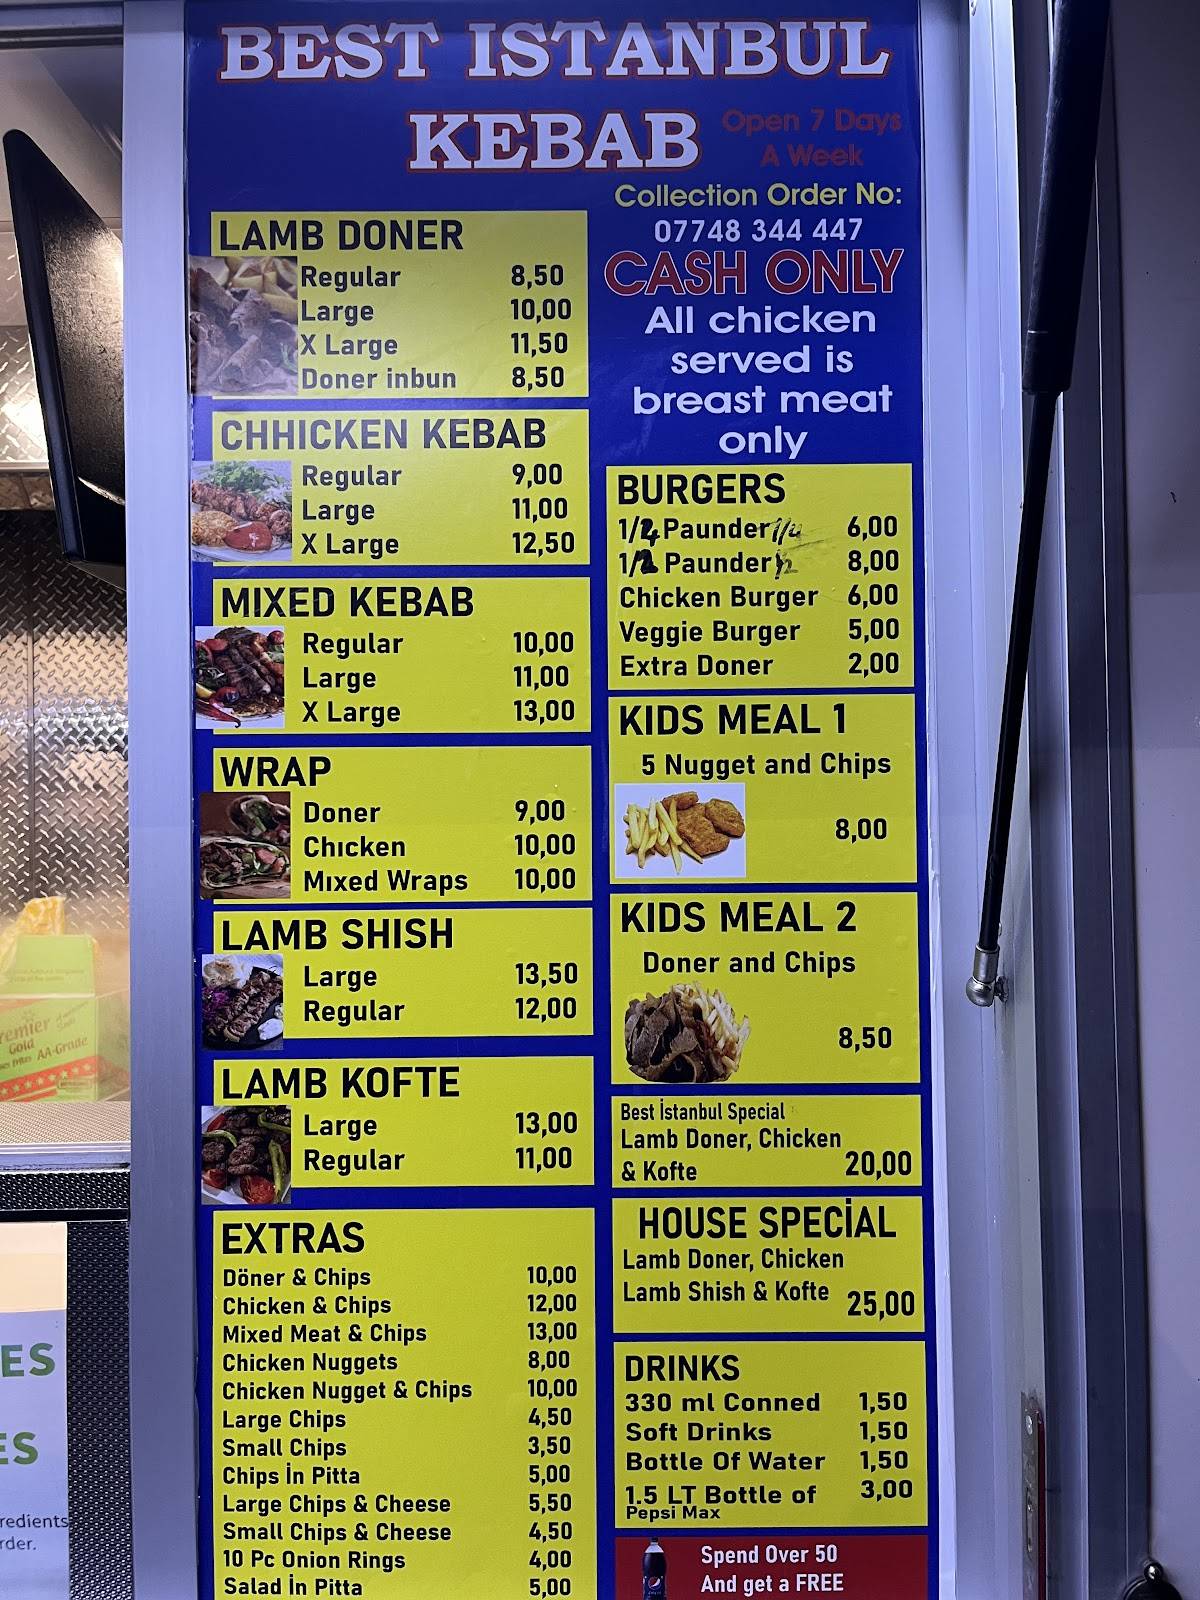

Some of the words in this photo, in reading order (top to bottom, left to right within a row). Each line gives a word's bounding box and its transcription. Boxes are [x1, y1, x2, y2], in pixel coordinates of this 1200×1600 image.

[219, 21, 441, 81] BEST
[467, 19, 891, 79] ISTANBUL
[721, 109, 800, 136] Open
[811, 107, 824, 130] 7
[835, 108, 901, 135] Days
[408, 111, 700, 171] KEBAB
[760, 144, 780, 166] A
[787, 144, 864, 167] Week
[615, 184, 757, 207] Collection
[768, 183, 847, 205] Order
[857, 182, 901, 204] No:
[220, 220, 323, 250] LAMB
[339, 220, 463, 250] DONER
[655, 219, 740, 242] 07748
[752, 219, 802, 242] 344
[813, 218, 862, 240] 447
[302, 266, 401, 292] Regular
[512, 265, 563, 289] 8,50
[604, 250, 746, 296] CASH
[765, 248, 904, 295] ONLY
[645, 306, 693, 333] All
[709, 305, 875, 333] chicken
[671, 345, 809, 374] served
[827, 345, 853, 372] is
[302, 368, 377, 389] Doner
[388, 368, 455, 388] inbun
[513, 367, 564, 392] 8,50
[634, 386, 766, 414] breast
[781, 385, 892, 412] meat
[222, 419, 407, 450] CHHICKEN
[424, 418, 545, 448] KEBAB
[719, 426, 808, 459] only
[619, 473, 785, 504] BURGERS
[664, 518, 771, 539] Paunder
[848, 516, 897, 541] 6,00
[666, 552, 772, 573] Paunder
[849, 550, 898, 575] 8,00
[223, 587, 334, 617] MIXED
[351, 587, 473, 616] KEBAB
[621, 587, 720, 608] Chicken
[732, 586, 818, 612] Burger
[848, 584, 897, 609] 6,00
[621, 656, 686, 676] Extra
[698, 655, 773, 675] Doner
[849, 653, 898, 678] 2,00
[304, 667, 376, 693] Large
[514, 666, 568, 690] 11,00
[621, 705, 703, 735] KIDS
[719, 704, 820, 734] MEAL
[834, 703, 844, 733] 1
[220, 757, 330, 786] WRAP
[642, 754, 654, 775] 5
[666, 754, 755, 780] Nugget
[765, 753, 810, 774] and
[821, 753, 890, 779] Chips
[836, 818, 886, 843] 8,00
[515, 834, 575, 859] 10,00
[387, 870, 467, 896] Wraps
[515, 868, 575, 893] 10,00
[622, 902, 705, 932] KIDS
[721, 902, 823, 932] MEAL
[837, 901, 856, 931] 2
[223, 920, 326, 950] LAMB
[342, 918, 452, 949] SHISH
[305, 1000, 405, 1027] Regular
[516, 997, 576, 1022] 12,00
[9, 1038, 34, 1055] Gold
[223, 1068, 326, 1099] LAMB
[343, 1067, 459, 1098] KOFTE
[621, 1103, 654, 1120] Best
[728, 1102, 785, 1124] Special
[305, 1115, 376, 1141] Large
[516, 1112, 577, 1138] 13,00
[622, 1129, 677, 1148] Lamb
[687, 1128, 751, 1151] Doner,
[760, 1128, 840, 1148] Chicken
[622, 1161, 635, 1181] &
[644, 1161, 696, 1181] Kofte
[846, 1151, 911, 1180] 20,00
[640, 1207, 746, 1239] HOUSE
[223, 1222, 364, 1254] EXTRAS
[224, 1269, 285, 1286] Döner
[293, 1268, 306, 1285] &
[315, 1268, 370, 1289] Chips
[528, 1266, 576, 1287] 10,00
[624, 1281, 680, 1301] Lamb
[689, 1281, 745, 1301] Shish
[754, 1281, 767, 1301] &
[776, 1281, 828, 1301] Kofte
[848, 1291, 914, 1320] 25,00
[224, 1325, 282, 1343] Mixed
[291, 1325, 340, 1342] Meat
[348, 1324, 362, 1341] &
[371, 1324, 426, 1346] Chips
[528, 1322, 576, 1343] 13,00
[626, 1355, 739, 1381] DRINKS
[223, 1382, 304, 1399] Chicken
[313, 1382, 385, 1403] Nugget
[394, 1381, 408, 1398] &
[416, 1380, 472, 1402] Chips
[528, 1379, 577, 1400] 10,00
[626, 1393, 671, 1411] 330
[683, 1393, 714, 1411] ml
[724, 1393, 819, 1411] Conned
[859, 1392, 907, 1414] 1,50
[223, 1439, 282, 1456] Small
[291, 1438, 346, 1460] Chips
[528, 1436, 570, 1457] 3,50
[627, 1452, 702, 1470] Bottle
[714, 1452, 740, 1470] Of
[749, 1452, 825, 1470] Water
[860, 1451, 907, 1472] 1,50
[223, 1467, 279, 1489] Chips
[313, 1467, 359, 1484] Pitta
[529, 1465, 570, 1486] 5,00
[626, 1486, 657, 1504] 1.5
[669, 1486, 696, 1504] LT
[706, 1486, 781, 1504] Bottle
[792, 1486, 816, 1503] of
[861, 1480, 912, 1502] 3,00
[627, 1506, 675, 1522] Pepsi
[683, 1506, 720, 1519] Max
[224, 1523, 283, 1539] Small
[291, 1523, 346, 1545] Chips
[354, 1523, 368, 1540] &
[377, 1523, 451, 1540] Cheese
[529, 1522, 572, 1543] 4,50
[224, 1550, 243, 1567] 10
[252, 1550, 274, 1567] Pc
[283, 1551, 339, 1568] Onion
[349, 1551, 405, 1572] Rings
[530, 1550, 571, 1571] 4,00
[702, 1545, 758, 1568] Spend
[766, 1545, 809, 1563] Over
[816, 1545, 837, 1562] 50
[701, 1575, 736, 1592] And
[744, 1576, 772, 1597] get
[779, 1579, 789, 1591] a
[797, 1574, 843, 1591] FREE
